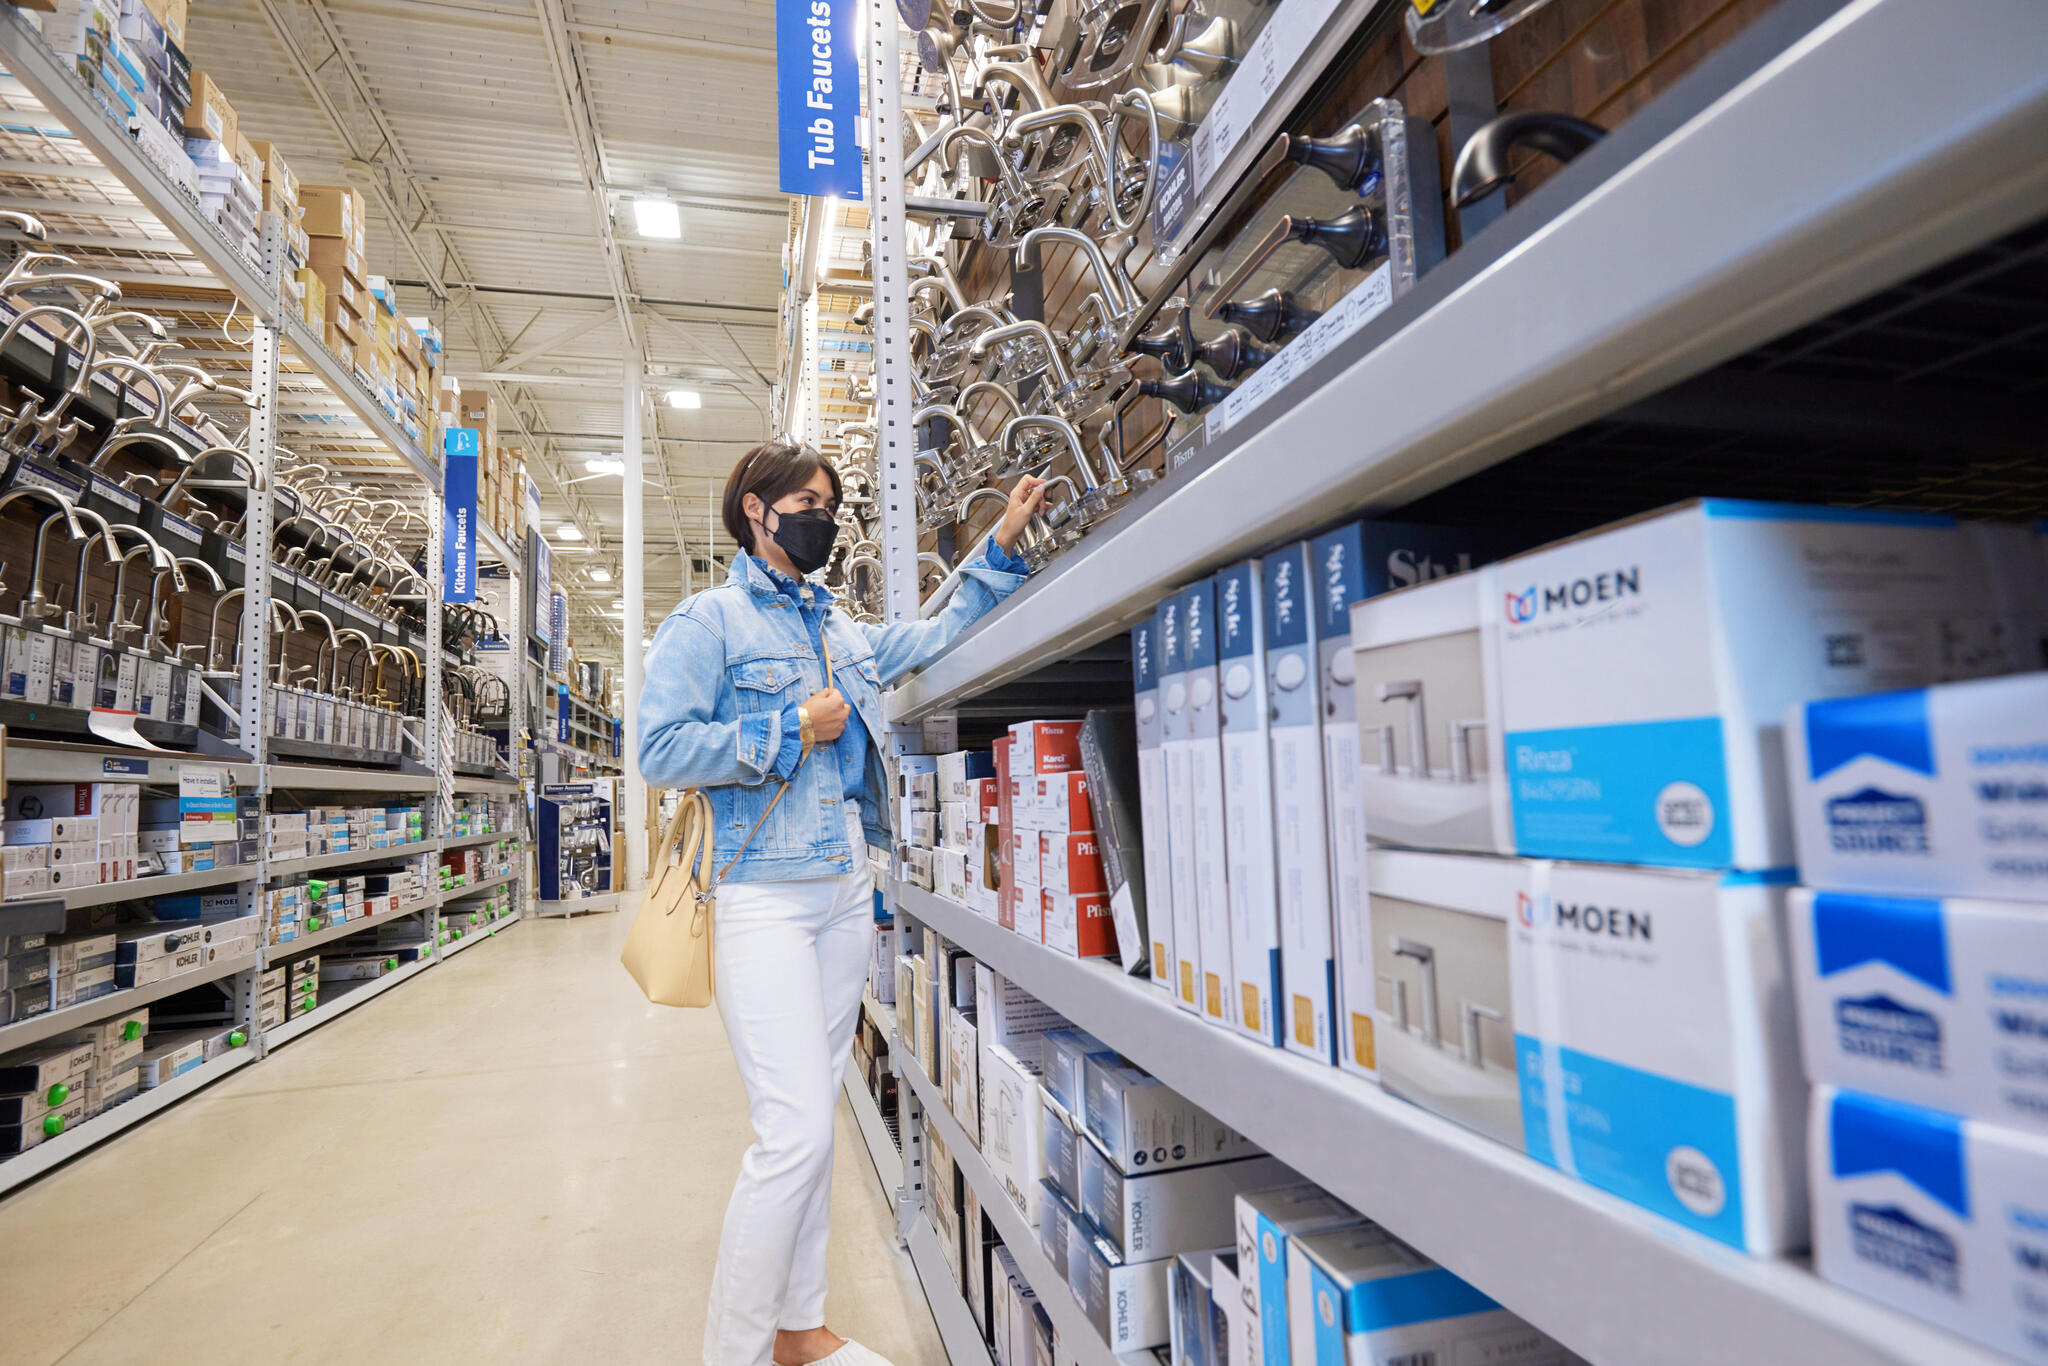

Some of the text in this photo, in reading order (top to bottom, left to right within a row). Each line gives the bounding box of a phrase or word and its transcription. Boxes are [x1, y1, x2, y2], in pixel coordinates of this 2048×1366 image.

[806, 1, 835, 169] Tub Faucets
[1160, 167, 1186, 213] KOHLER
[454, 507, 468, 594] Kitchen Faucets
[1544, 565, 1641, 613] MOEN
[1516, 744, 1573, 773] Rinza
[1077, 842, 1098, 856] Pfis
[1086, 904, 1112, 918] Pfist
[1555, 904, 1654, 943] MOEN
[180, 931, 200, 945] KOHLER
[176, 953, 198, 968] KOHLER
[1005, 1174, 1027, 1213] KOHLER
[1132, 1201, 1143, 1252] KOHLER
[1117, 1290, 1129, 1343] KOHLER
